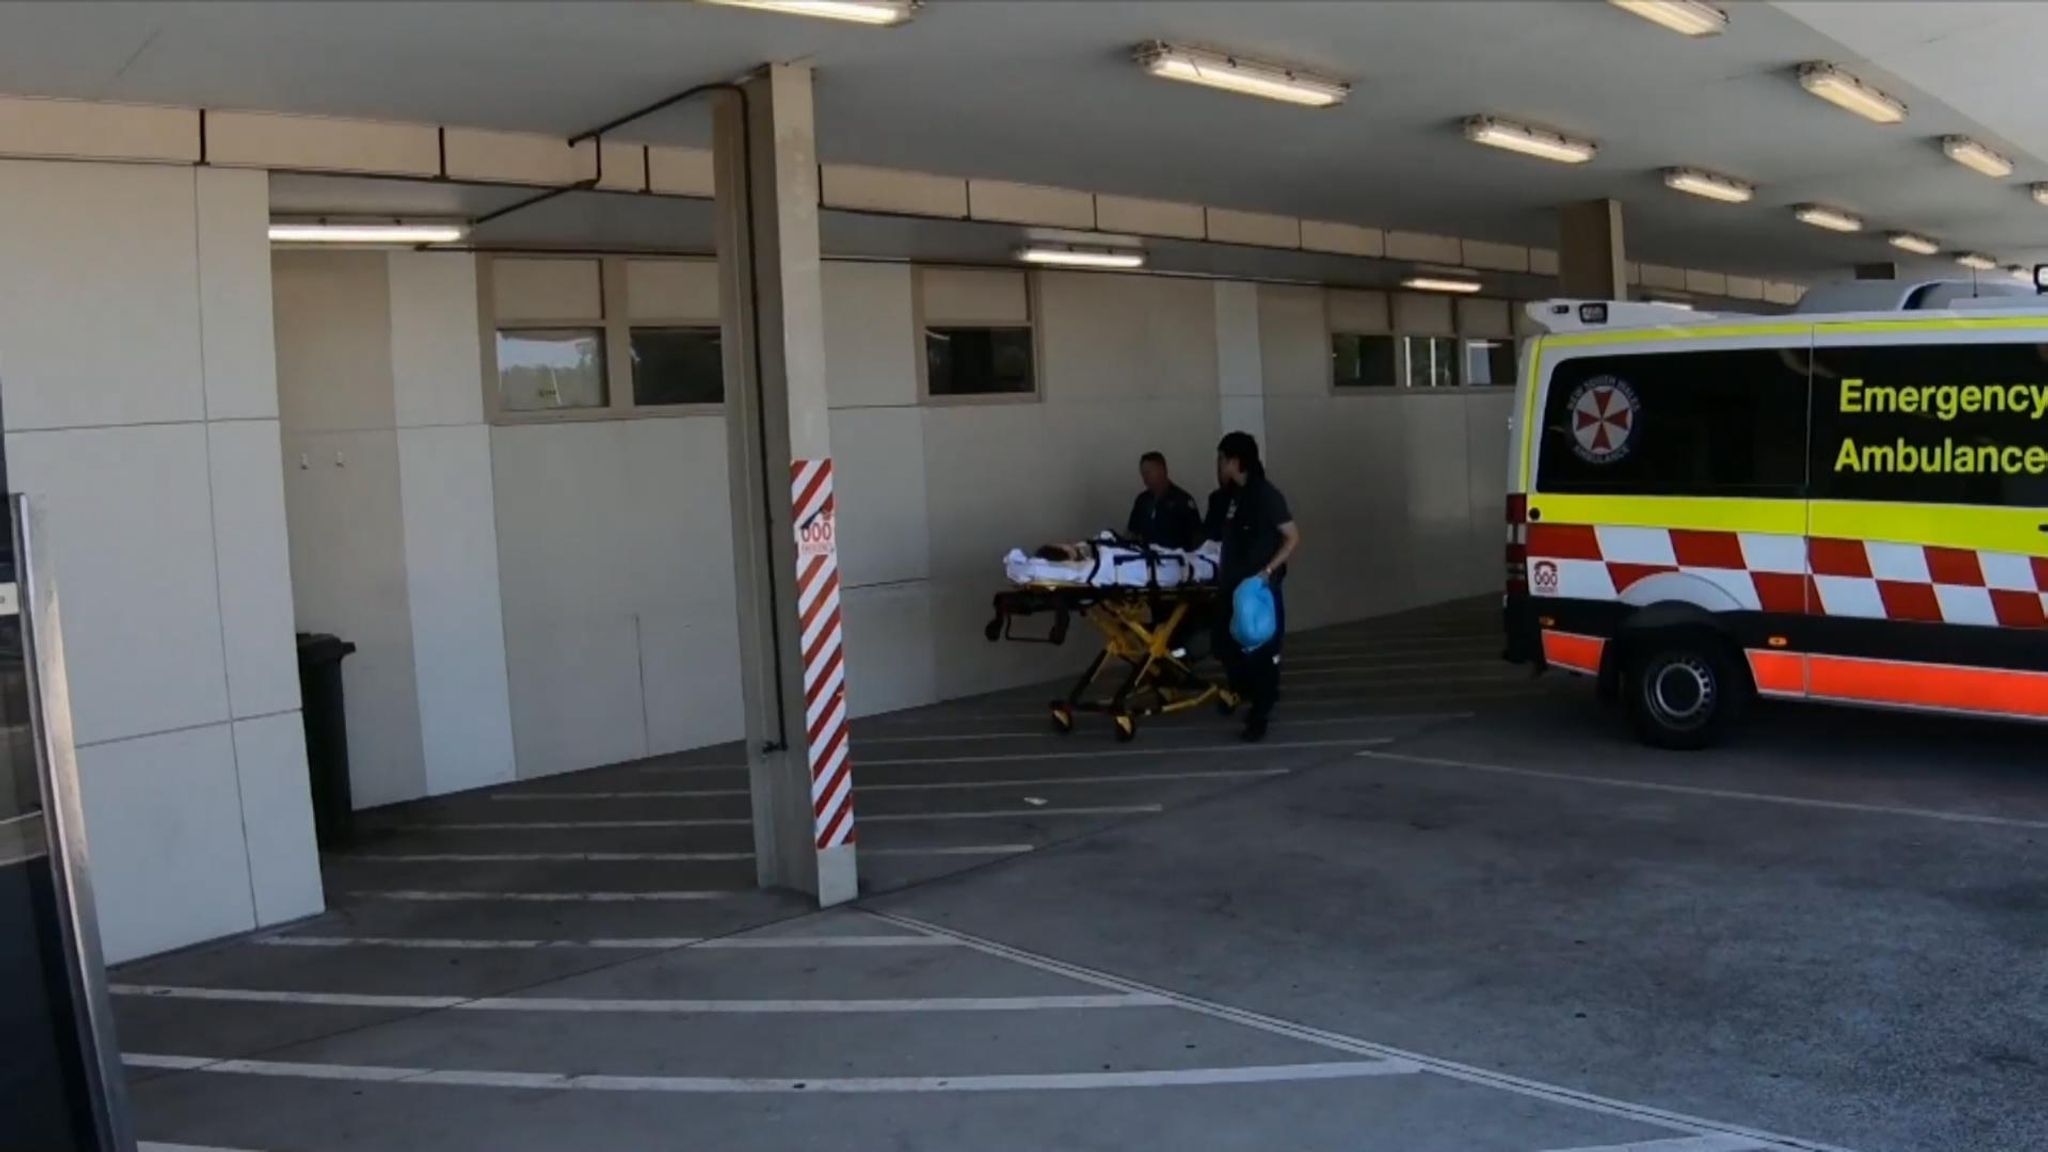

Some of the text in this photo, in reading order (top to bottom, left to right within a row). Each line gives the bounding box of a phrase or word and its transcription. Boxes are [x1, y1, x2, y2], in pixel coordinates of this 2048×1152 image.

[1839, 378, 2048, 421] Emergency
[1834, 437, 2047, 474] Ambulance
[801, 522, 831, 542] 000
